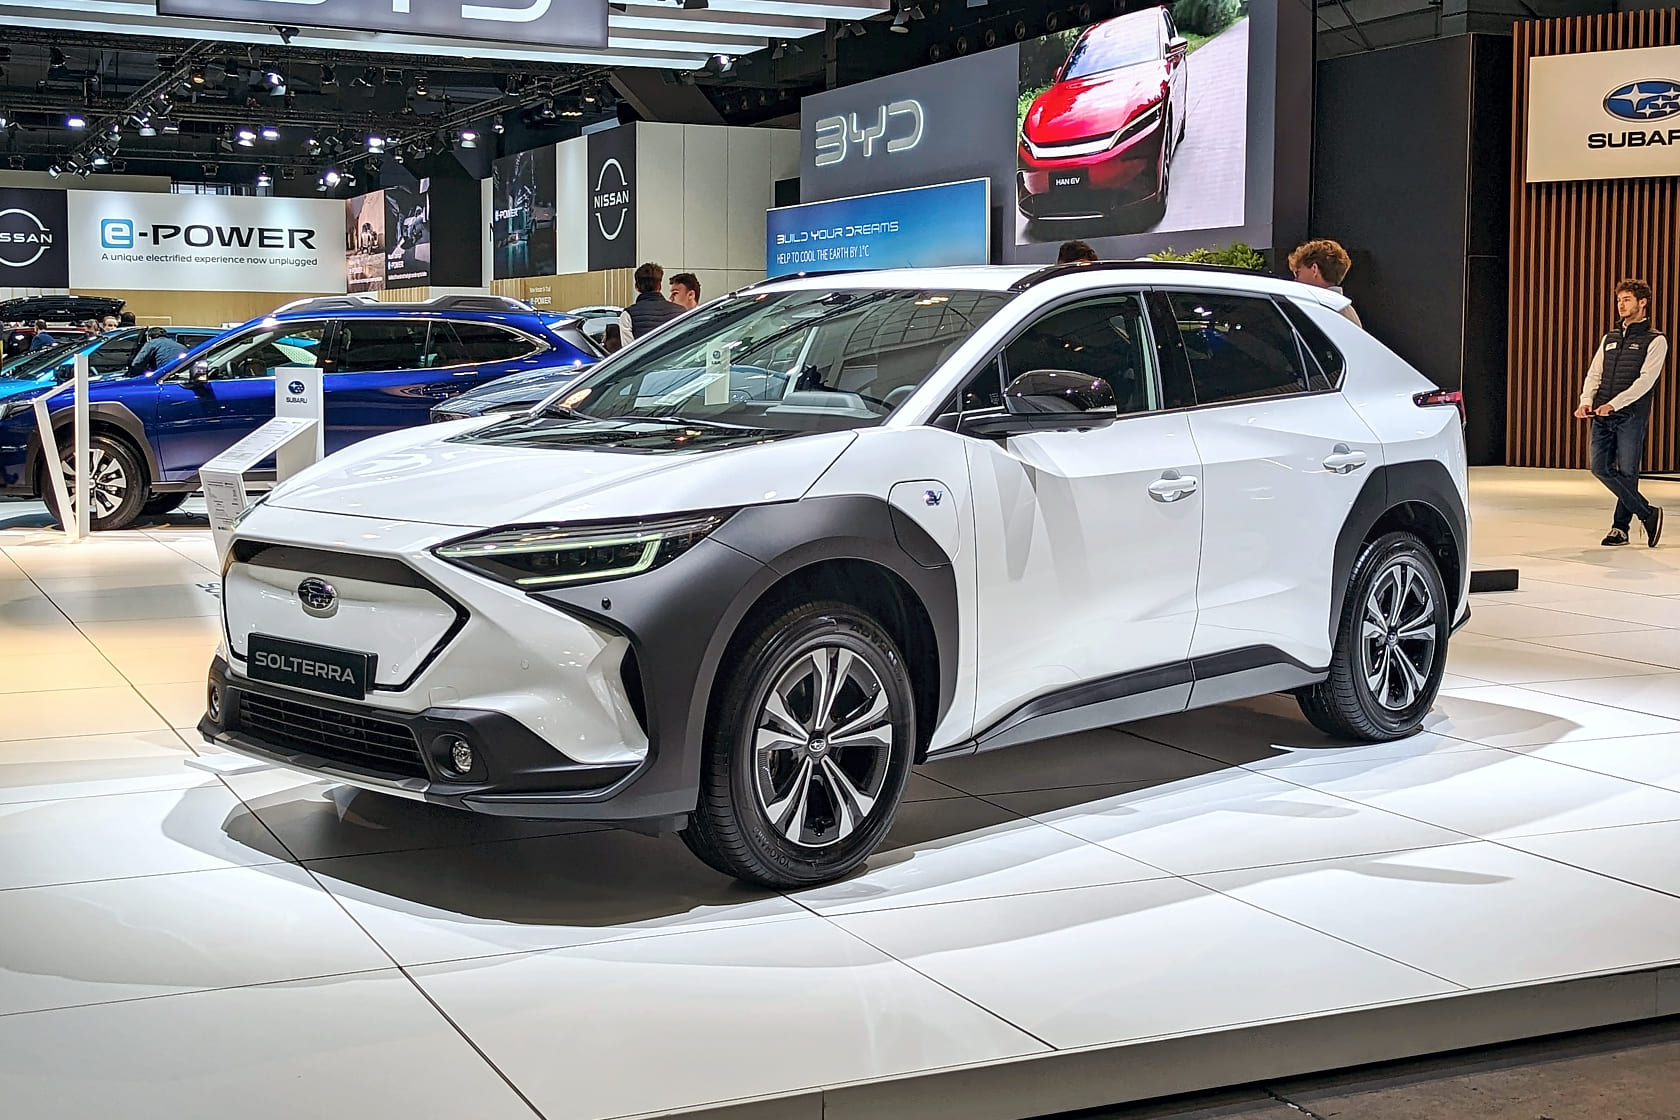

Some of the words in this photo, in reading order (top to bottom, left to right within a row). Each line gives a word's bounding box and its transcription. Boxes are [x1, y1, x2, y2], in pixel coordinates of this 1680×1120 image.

[816, 100, 923, 166] BYD
[1055, 178, 1070, 186] HAN
[594, 190, 629, 208] NISSAN
[101, 219, 316, 249] e-POWER
[777, 232, 809, 245] BUILD
[810, 227, 843, 240] YOUR
[845, 221, 899, 237] DREAMS
[101, 253, 109, 261] A
[111, 253, 144, 263] unique
[145, 253, 192, 263] electrified
[194, 255, 245, 264] experience
[246, 256, 267, 264] now
[269, 256, 318, 267] unplugged
[777, 252, 791, 265] HELP
[791, 251, 800, 263] TO
[800, 249, 816, 263] COOL
[817, 249, 828, 261] THE
[829, 247, 849, 260] EARTH
[849, 246, 858, 258] BY
[859, 244, 870, 258] 1°C
[255, 651, 356, 684] SOLTERRA
